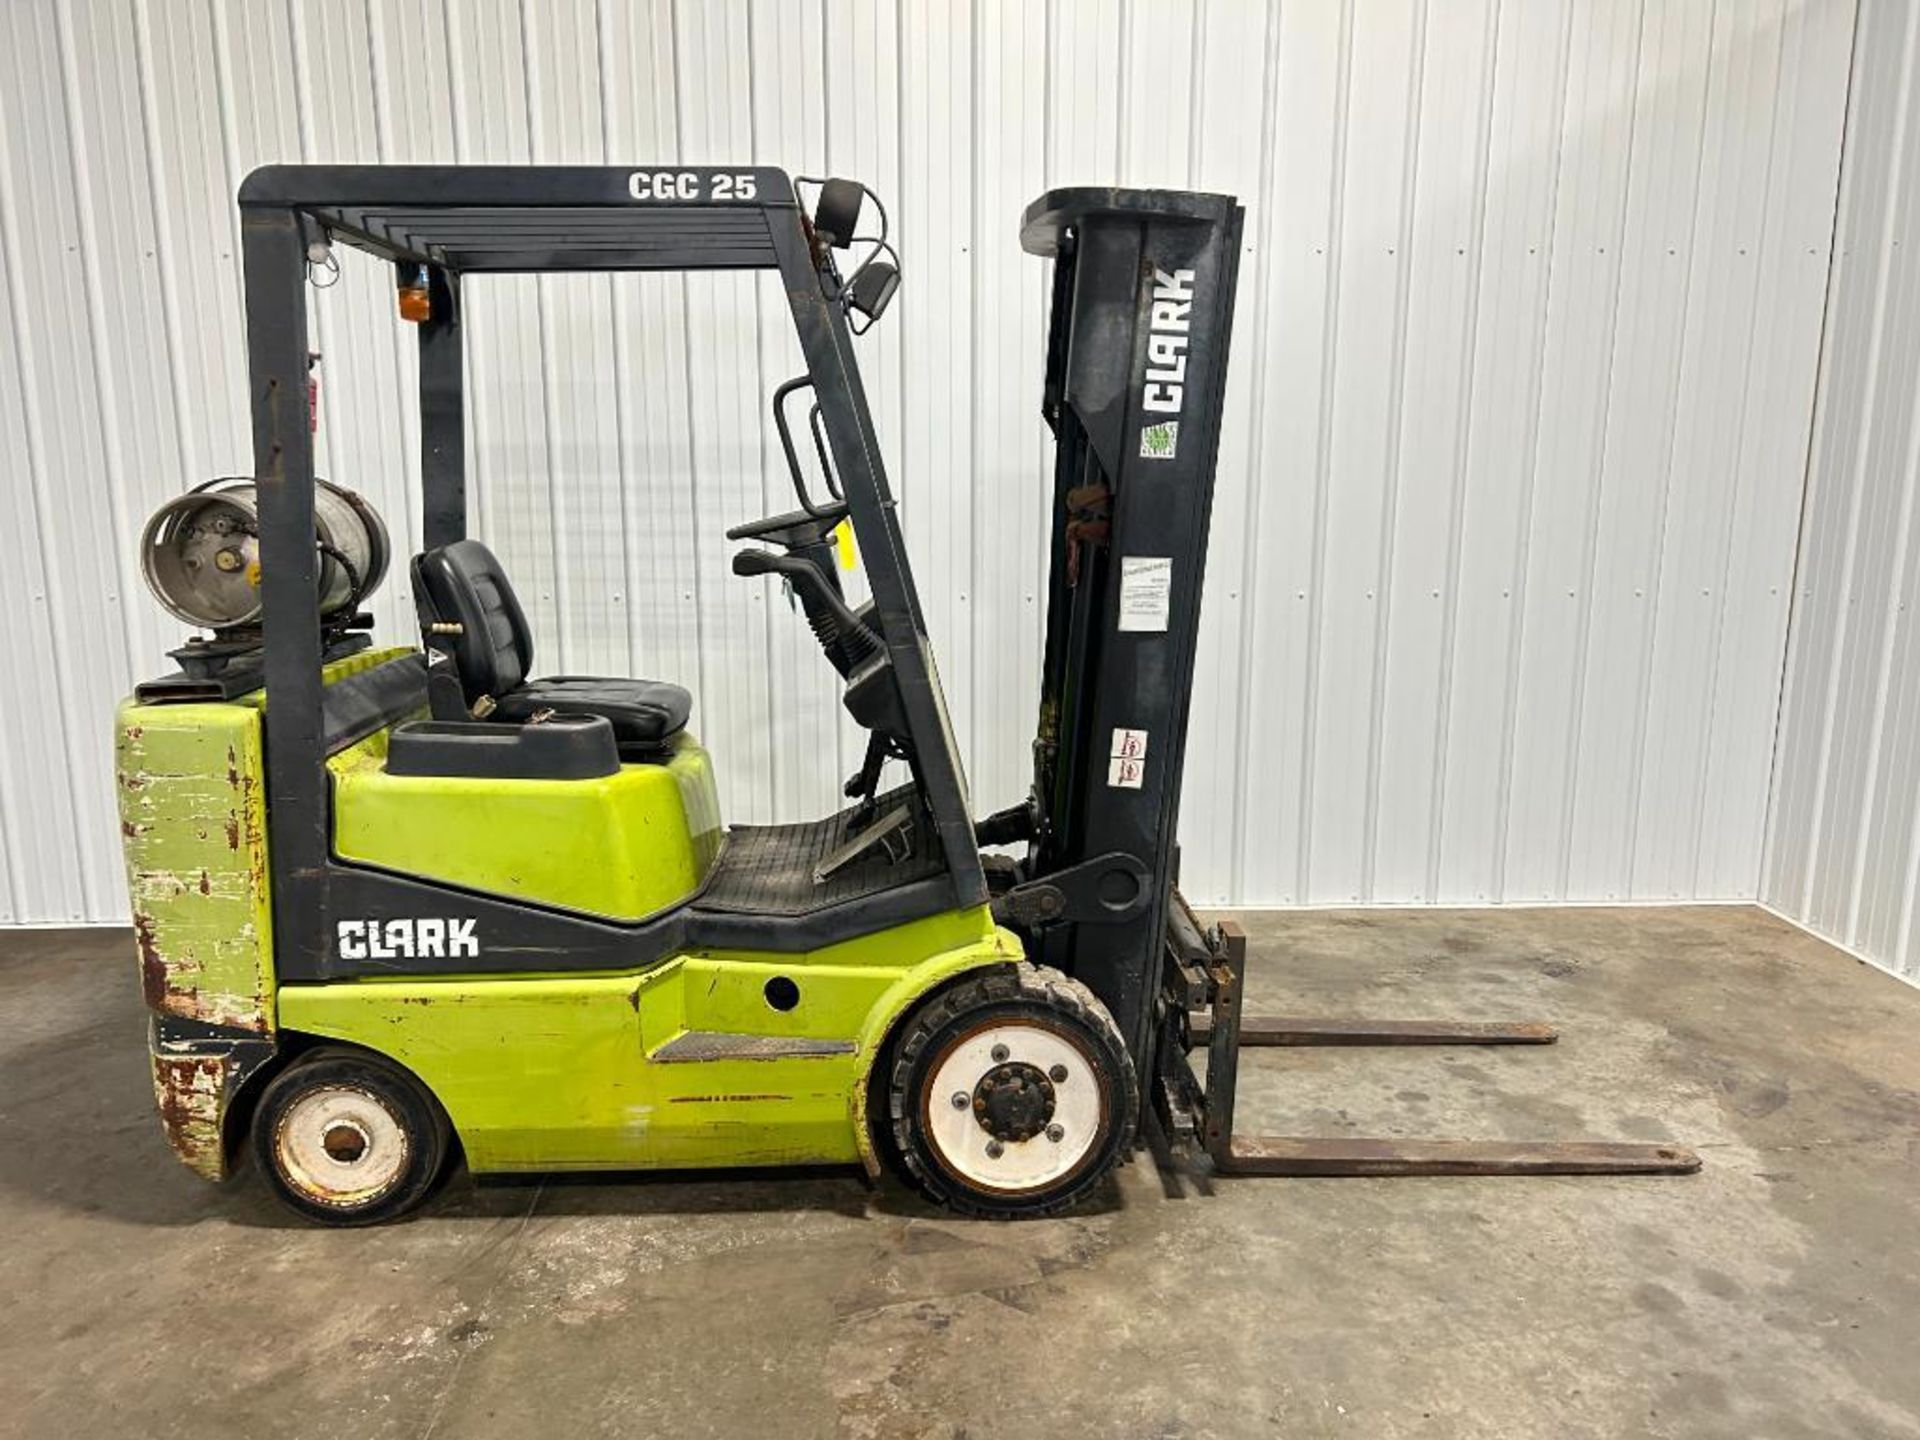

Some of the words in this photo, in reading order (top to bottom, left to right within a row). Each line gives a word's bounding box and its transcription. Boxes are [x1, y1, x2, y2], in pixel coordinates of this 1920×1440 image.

[629, 172, 699, 199] CGC
[711, 174, 757, 199] 25
[1143, 268, 1195, 412] CLARK
[337, 918, 479, 959] CLARK
